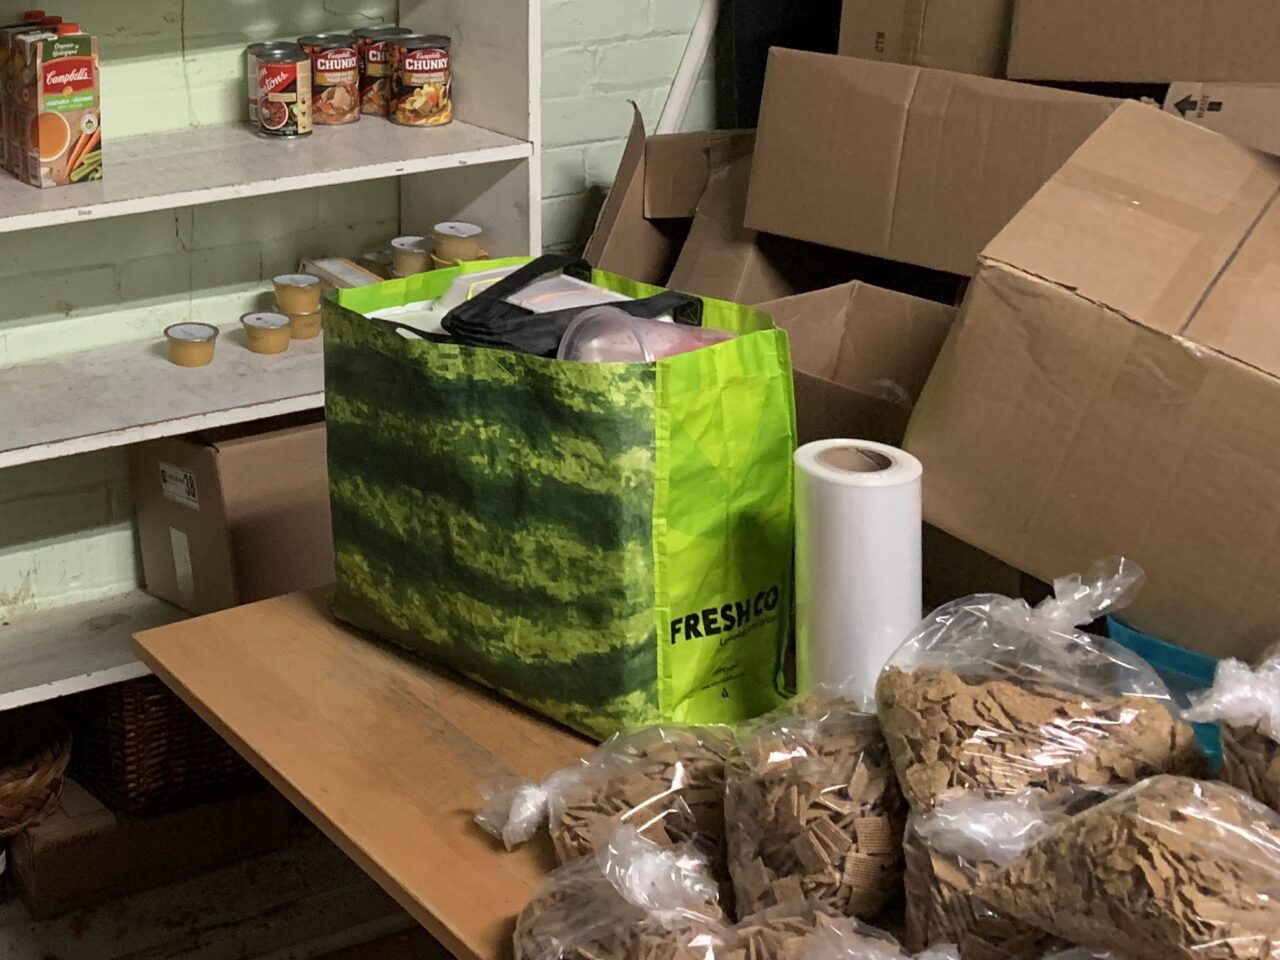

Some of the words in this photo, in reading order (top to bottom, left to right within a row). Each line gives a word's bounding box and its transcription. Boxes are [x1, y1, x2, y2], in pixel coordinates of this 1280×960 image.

[317, 57, 357, 71] CHUNKY
[405, 58, 448, 71] CHUNKY
[46, 68, 89, 86] Campbell's
